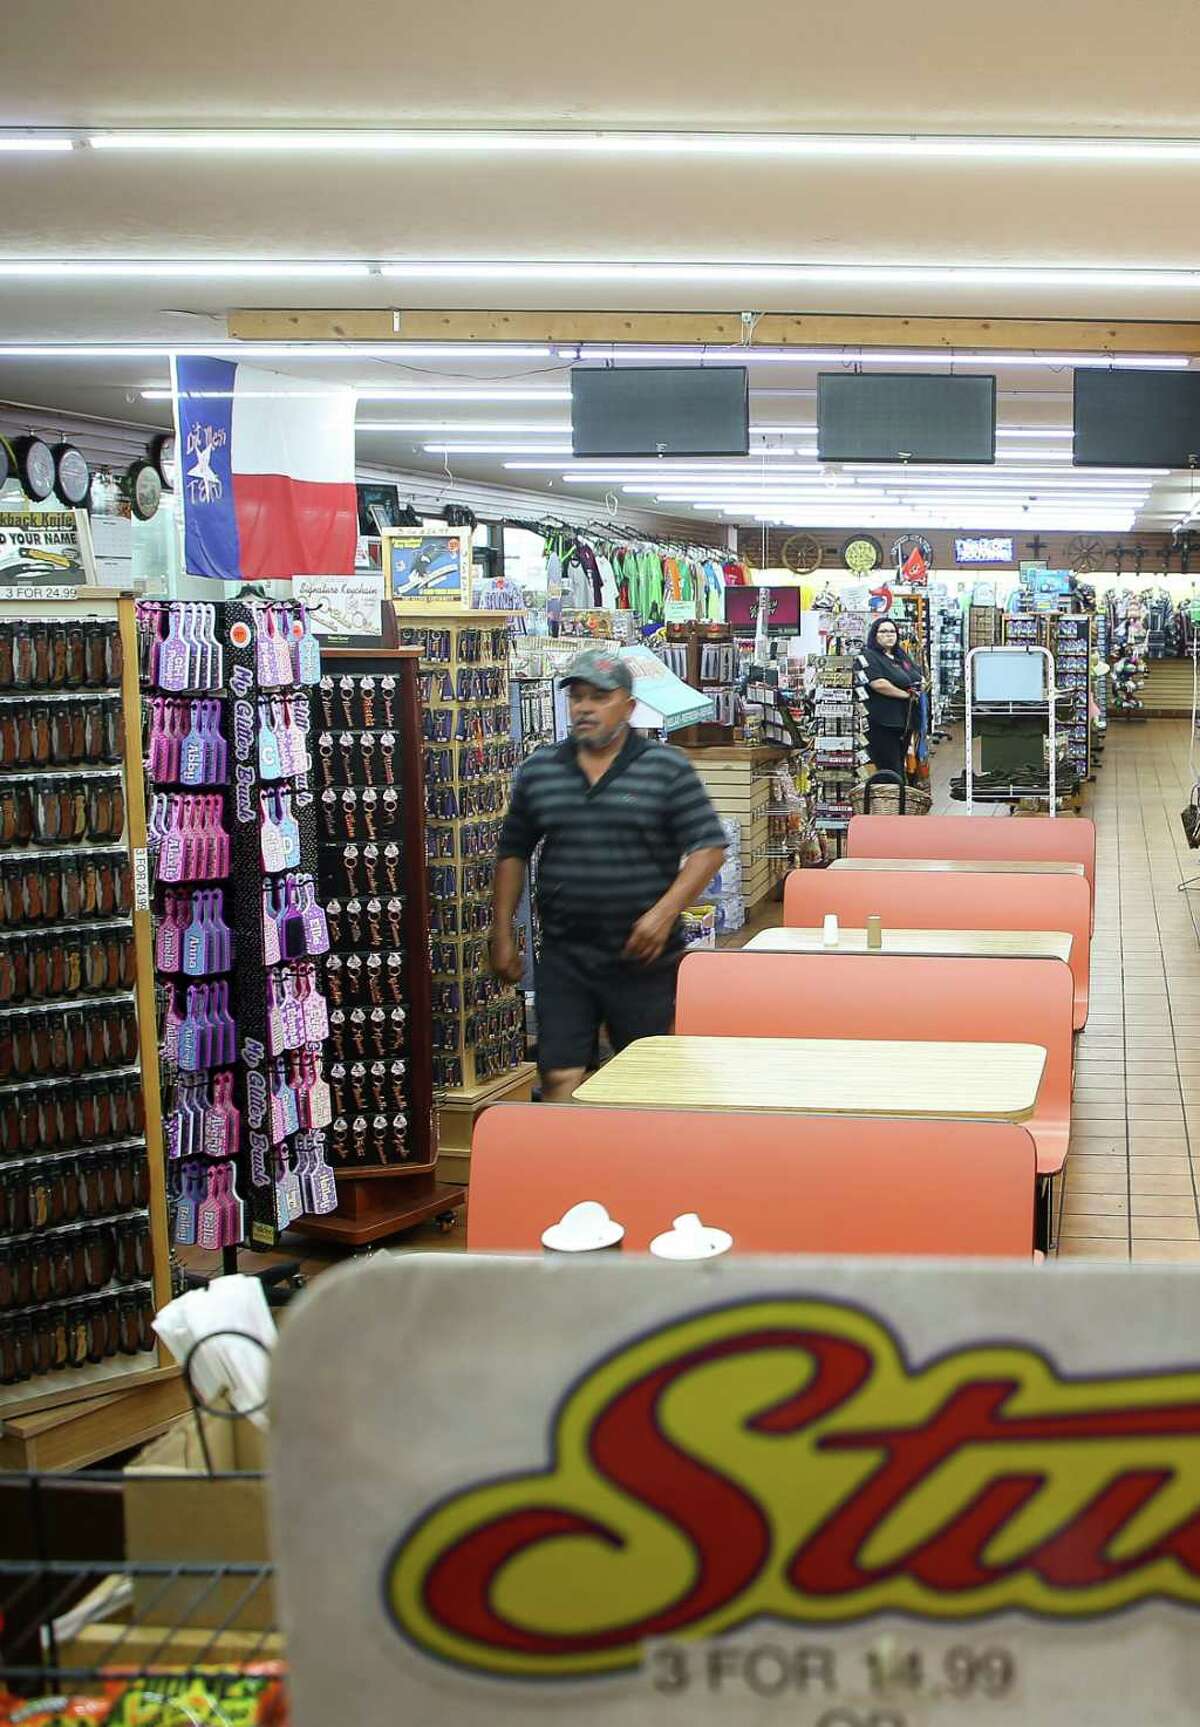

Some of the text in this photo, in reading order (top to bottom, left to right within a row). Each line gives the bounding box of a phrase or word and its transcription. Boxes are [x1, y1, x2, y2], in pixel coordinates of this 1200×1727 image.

[9, 533, 41, 545] YOUR
[44, 533, 77, 545] NAME
[5, 588, 77, 598] 3 FOR 24.99
[230, 665, 256, 823] My Glitter Brush
[136, 858, 146, 880] FOR
[242, 1036, 271, 1187] My Glitter Brush
[652, 1643, 690, 1695] 3
[705, 1643, 839, 1698] FOR
